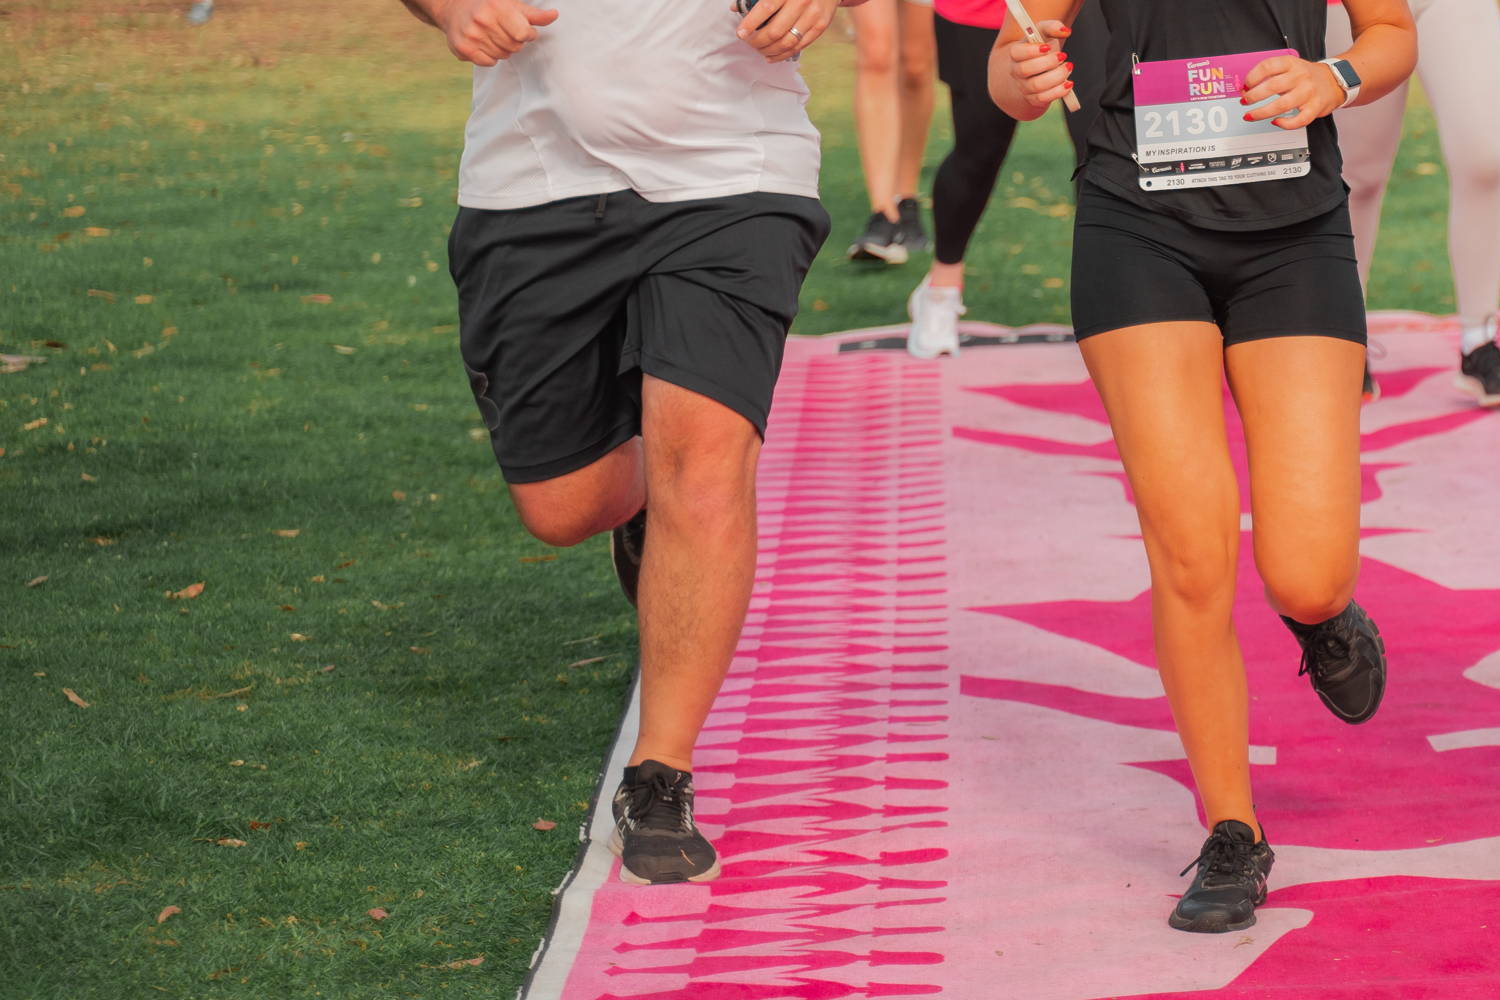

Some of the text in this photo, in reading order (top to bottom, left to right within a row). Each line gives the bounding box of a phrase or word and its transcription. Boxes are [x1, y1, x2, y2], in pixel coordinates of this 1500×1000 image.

[1188, 67, 1224, 83] FUN
[1189, 80, 1226, 96] RUN
[1143, 105, 1229, 138] 2130
[1157, 146, 1207, 156] INSPIRATION
[1167, 178, 1185, 186] 2130
[1283, 166, 1302, 175] 2130
